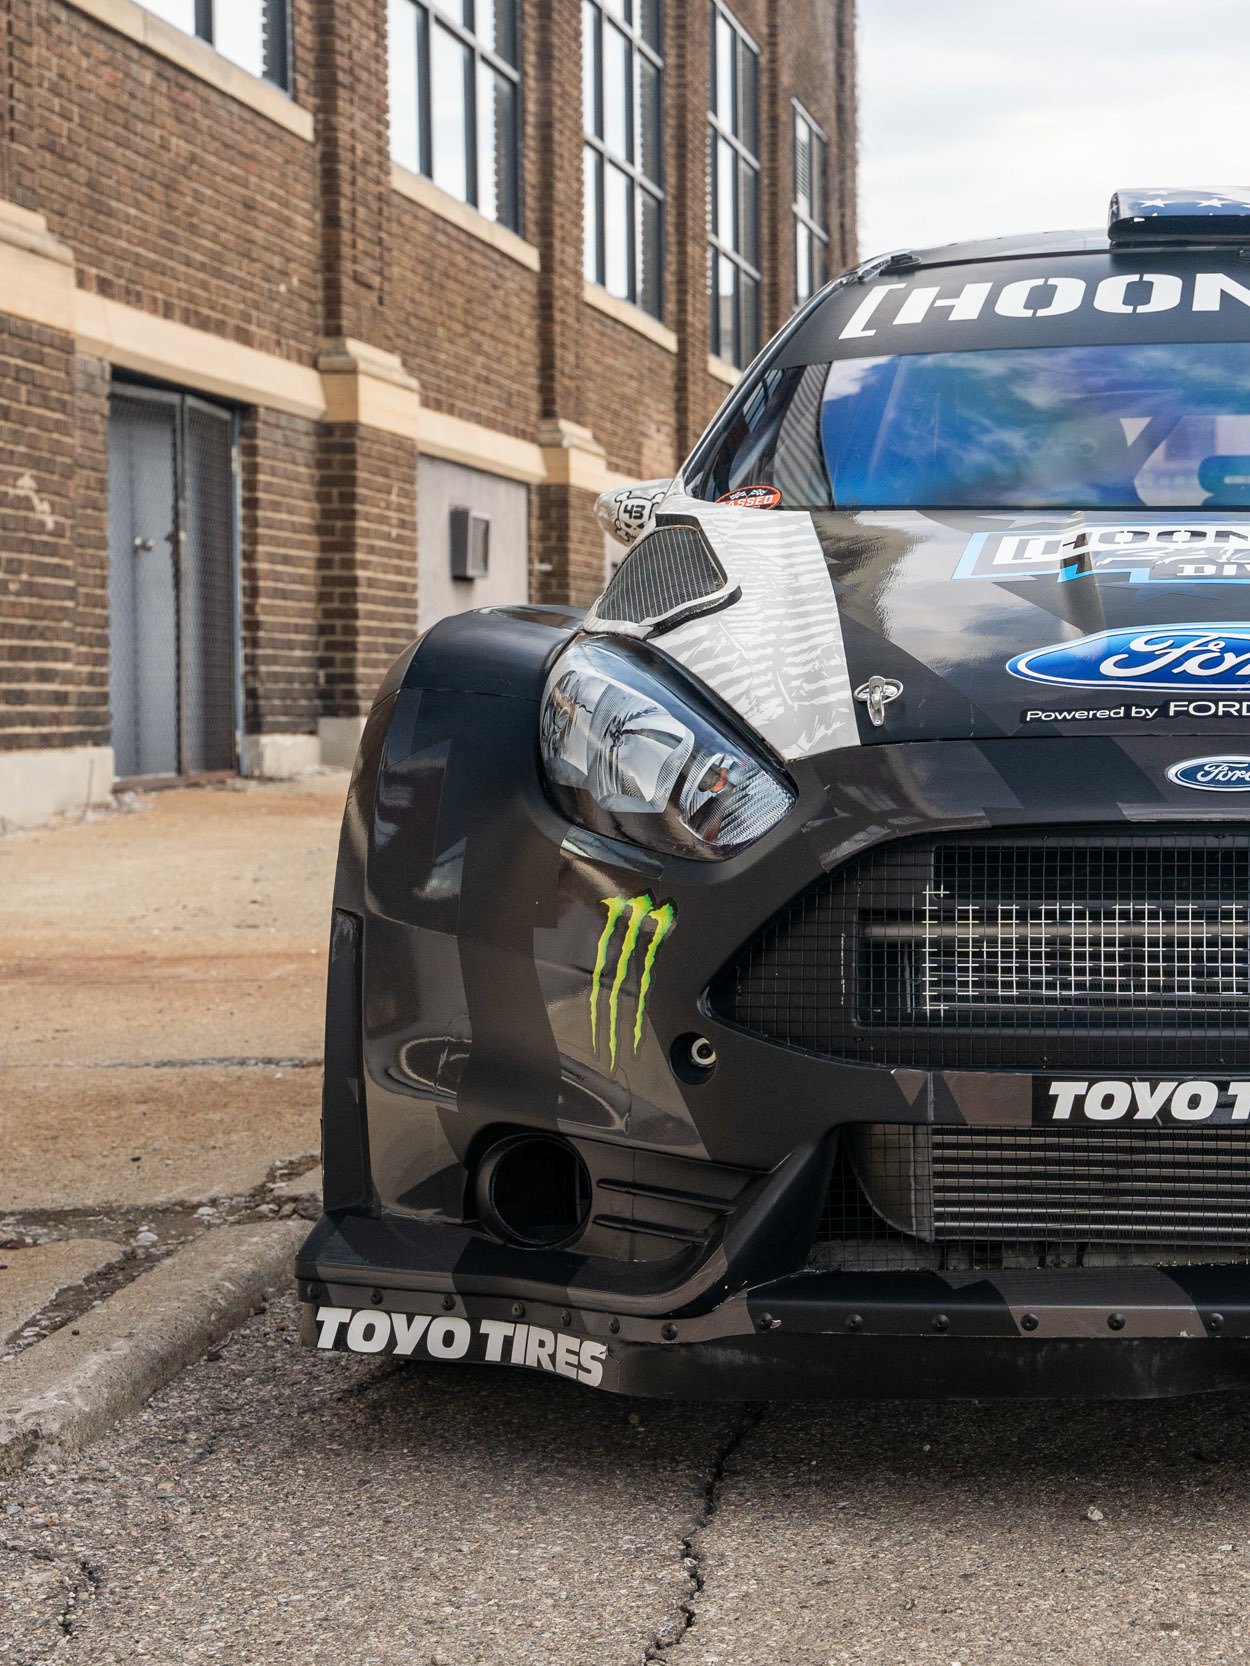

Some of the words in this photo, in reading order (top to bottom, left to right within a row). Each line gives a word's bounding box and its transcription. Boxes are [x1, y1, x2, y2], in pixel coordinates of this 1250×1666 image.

[726, 494, 775, 508] ASSED
[623, 503, 646, 520] 43
[1025, 706, 1125, 722] Powered
[1131, 706, 1158, 718] by
[1048, 1080, 1219, 1121] TOYO
[315, 1306, 471, 1360] TOYO
[479, 1318, 608, 1388] TIRES
